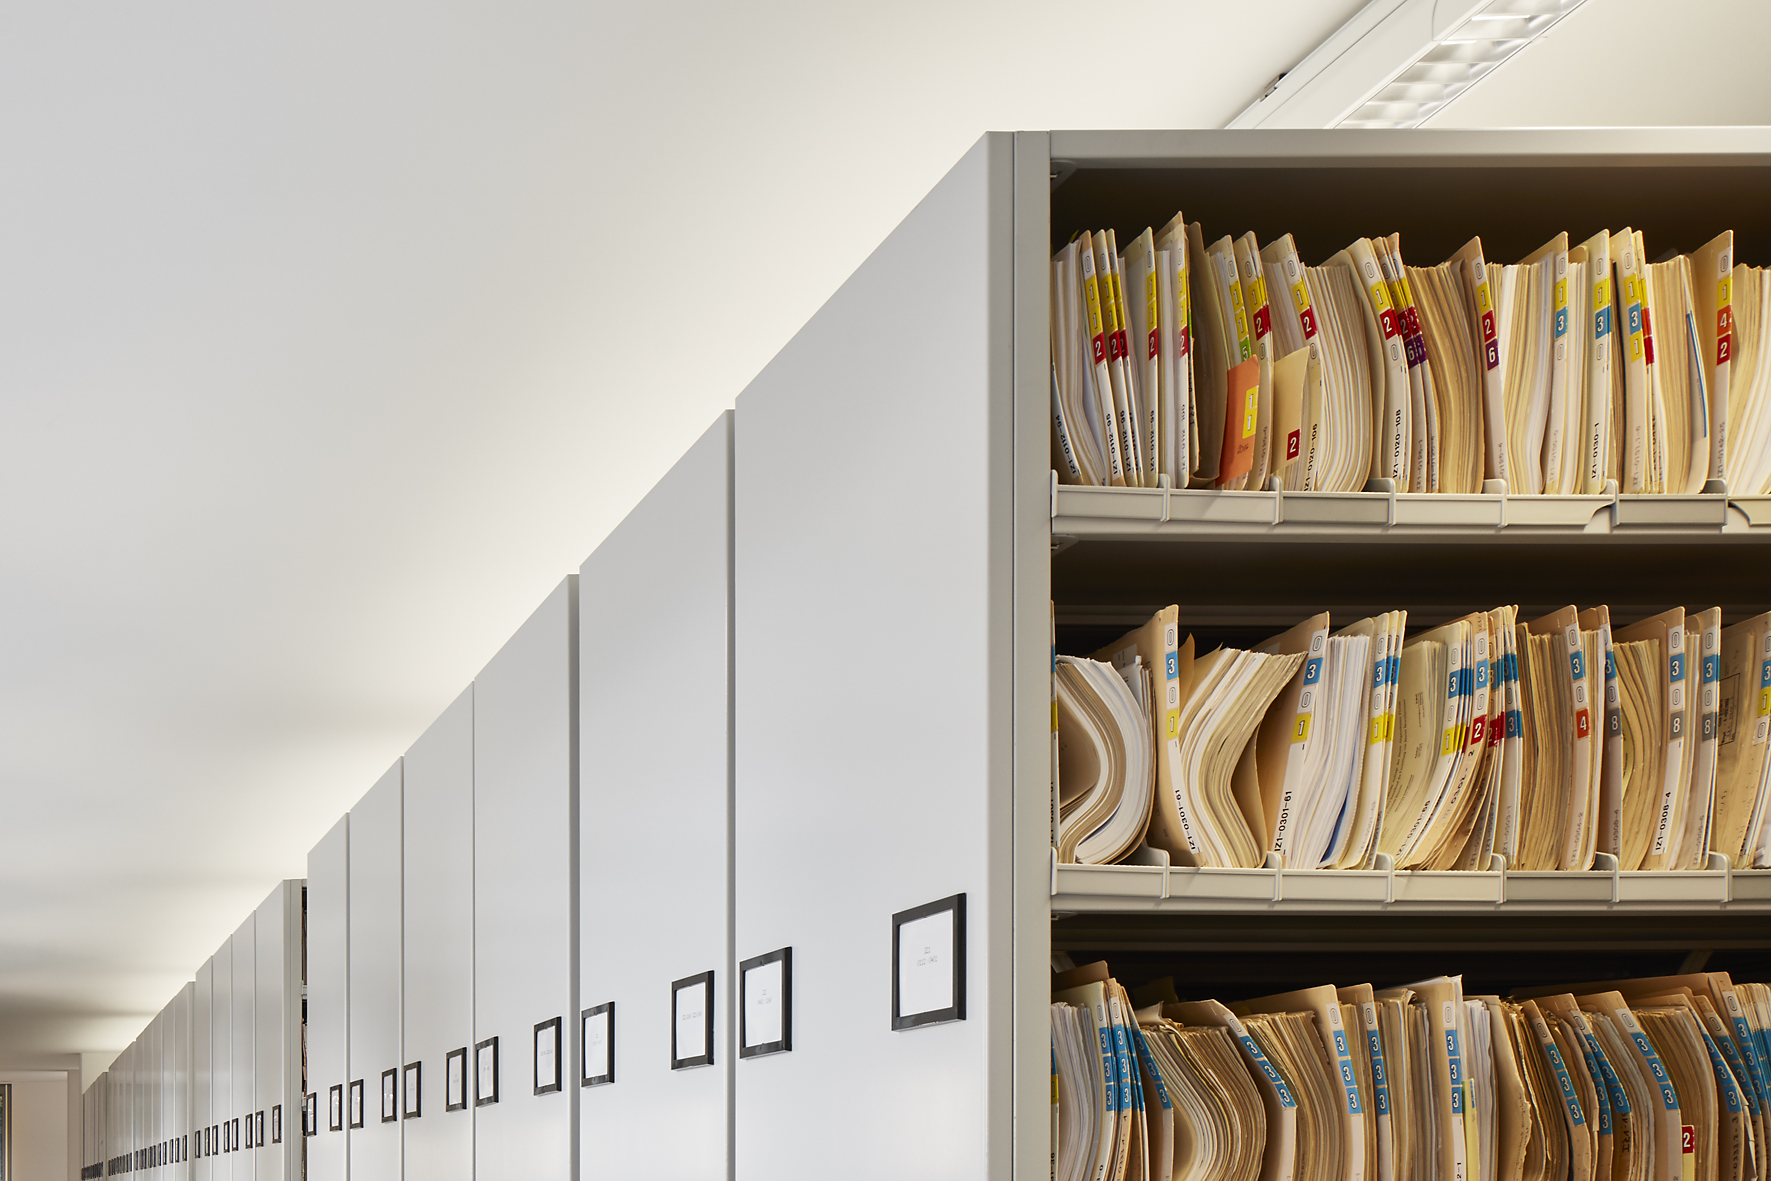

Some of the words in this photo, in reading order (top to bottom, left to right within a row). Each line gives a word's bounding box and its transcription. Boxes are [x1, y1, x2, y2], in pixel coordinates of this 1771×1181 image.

[1289, 437, 1297, 454] 2
[1591, 422, 1600, 479] IZ1-0130-1
[1175, 789, 1196, 850] IZ1-0301-61
[1274, 790, 1292, 852] IZ1-0301-61
[1655, 791, 1671, 851] IZ1-0308-4
[1683, 1132, 1691, 1148] 2
